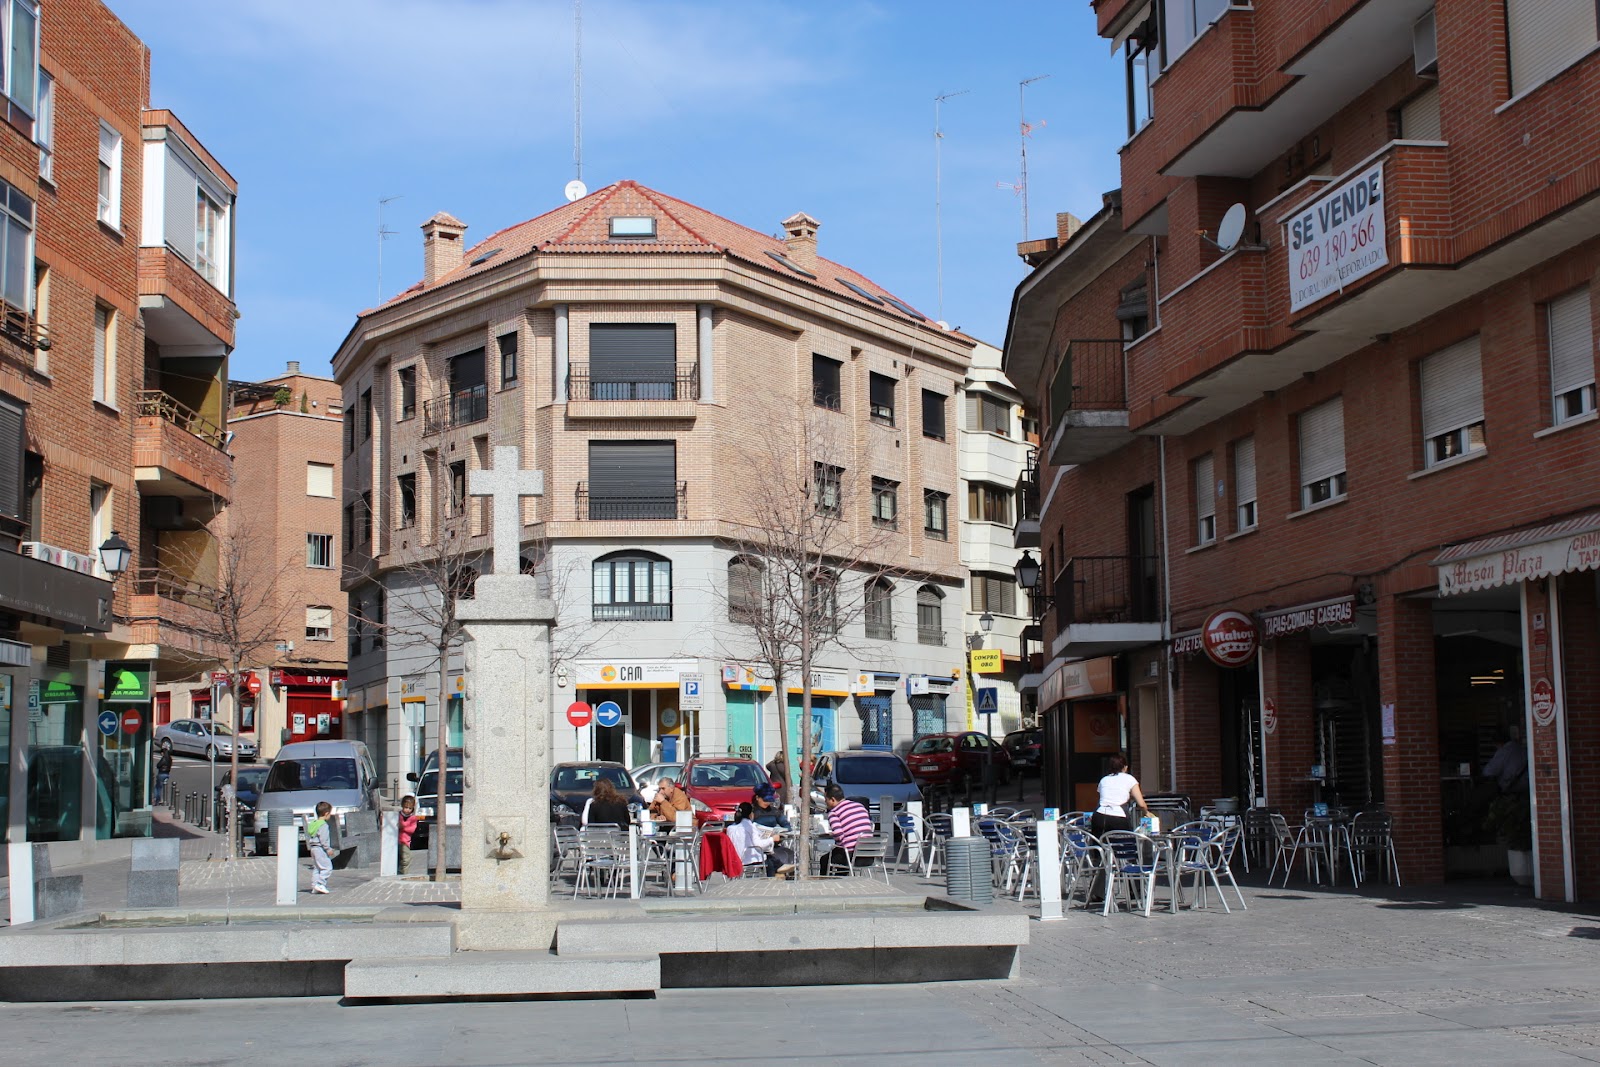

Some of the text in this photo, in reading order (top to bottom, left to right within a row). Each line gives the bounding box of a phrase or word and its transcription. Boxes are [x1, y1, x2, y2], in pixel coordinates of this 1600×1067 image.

[1292, 172, 1381, 250] SE VENDE
[1299, 213, 1376, 280] 639 180 566
[1451, 549, 1543, 587] Mesón Plaza
[1317, 602, 1352, 624] CASERAS
[620, 666, 643, 681] CAM
